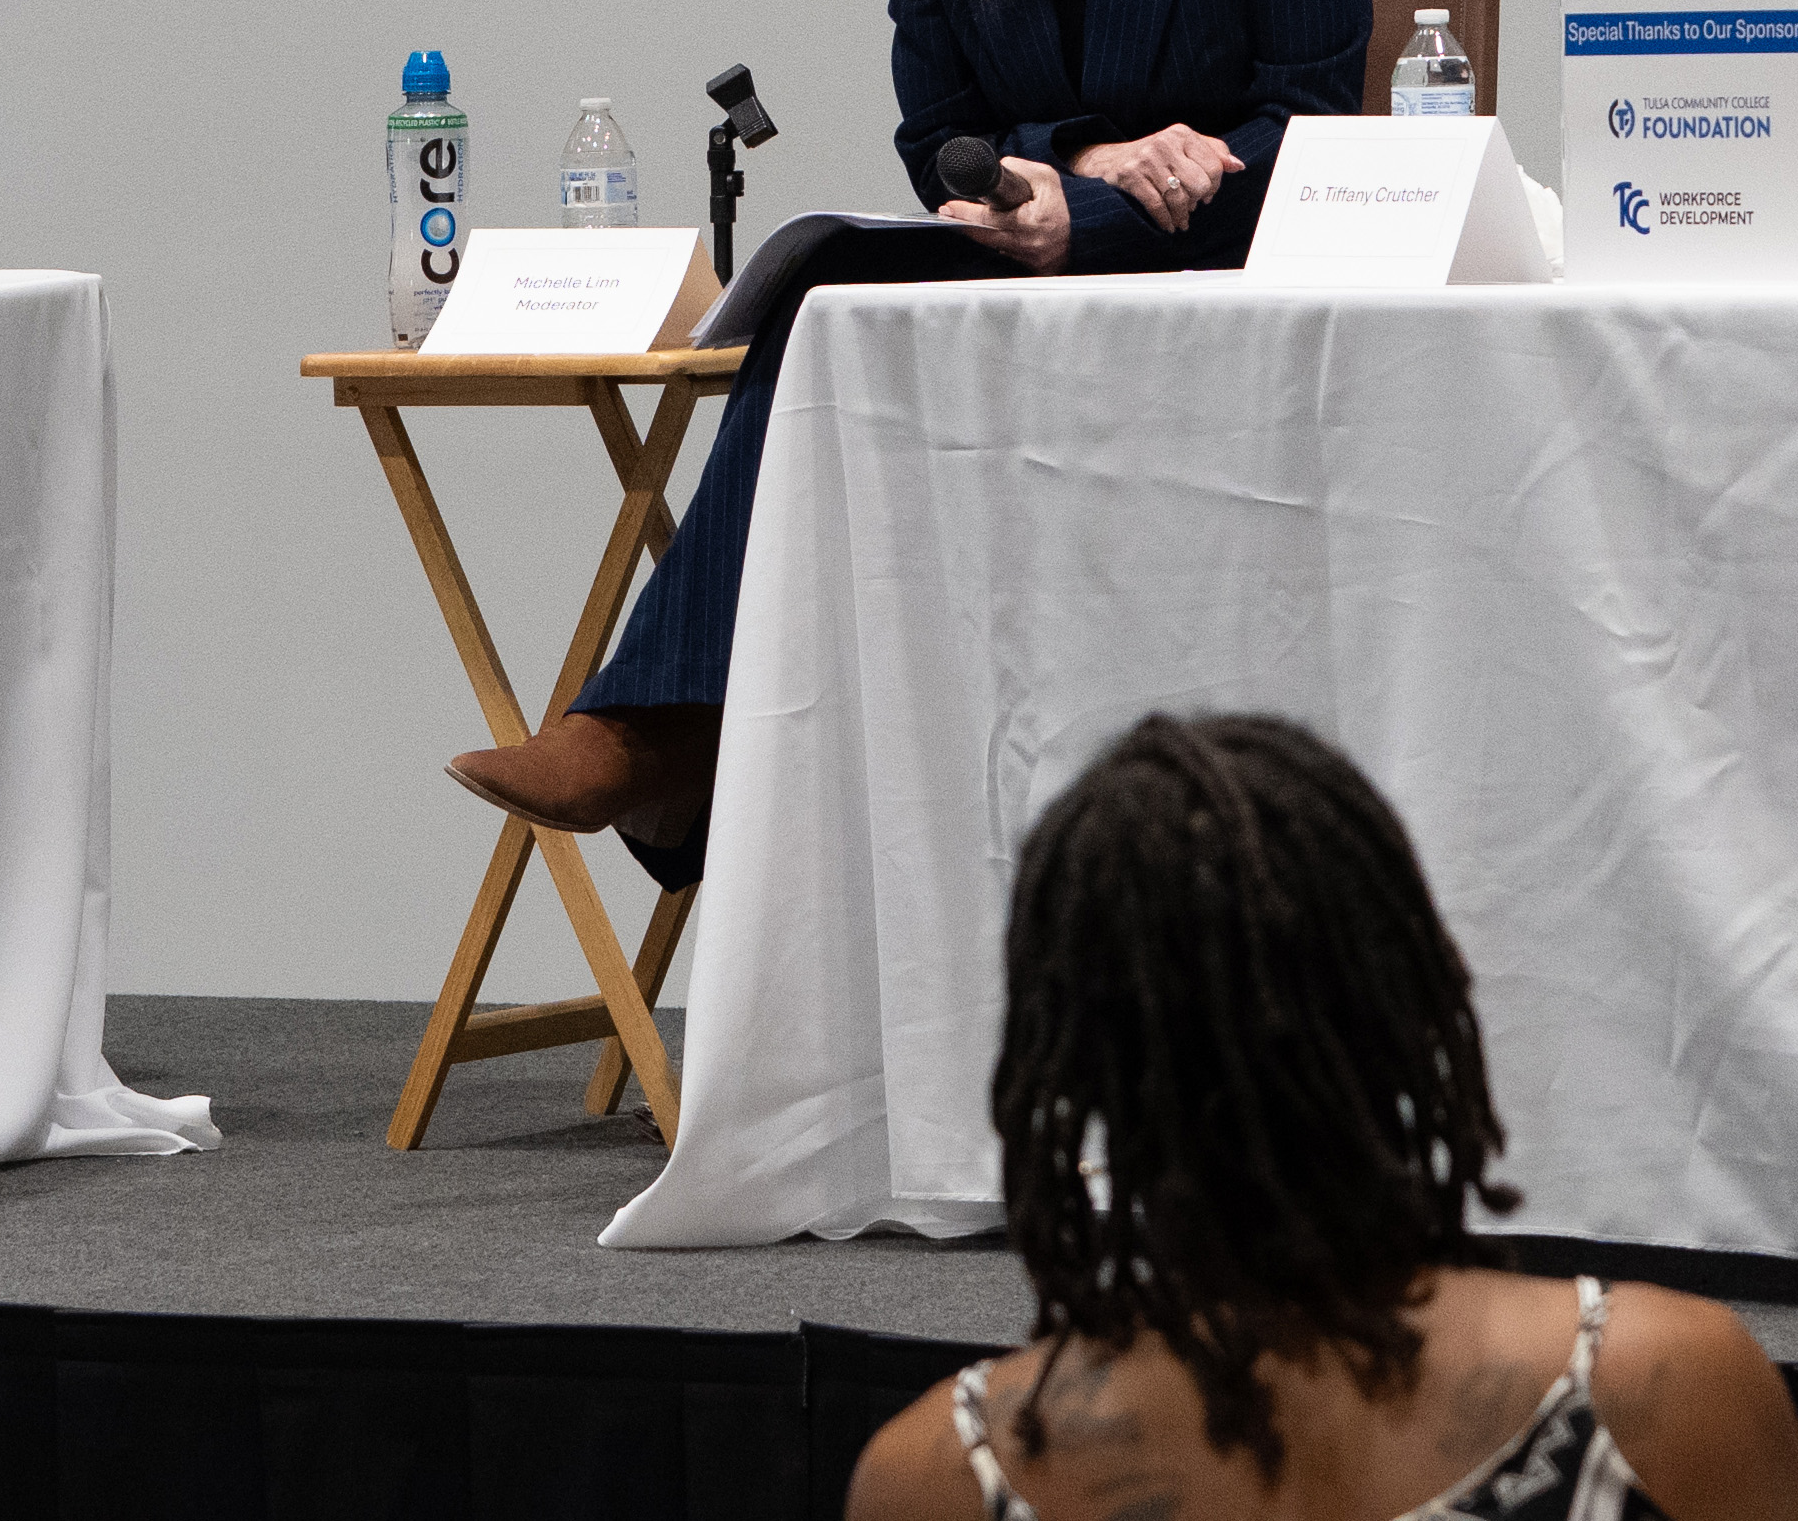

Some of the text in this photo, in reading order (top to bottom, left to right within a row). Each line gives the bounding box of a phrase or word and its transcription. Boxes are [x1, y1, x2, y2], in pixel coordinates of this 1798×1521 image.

[1568, 22, 1623, 45] Special
[1625, 21, 1681, 40] Thanks
[1684, 22, 1700, 40] to
[1703, 19, 1732, 39] Our
[1643, 96, 1770, 109] TULSA COMMUNITY COLLEGE
[1643, 116, 1770, 139] FOUNDATION
[1300, 186, 1440, 206] Dr. Tiffany Crutcher
[1659, 191, 1742, 206] WORKFORCE
[419, 137, 460, 284] core
[1613, 181, 1650, 235] TCC
[1659, 210, 1754, 225] DEVELOPMENT
[513, 276, 620, 289] Michelle Linn
[515, 299, 600, 311] Moderator
